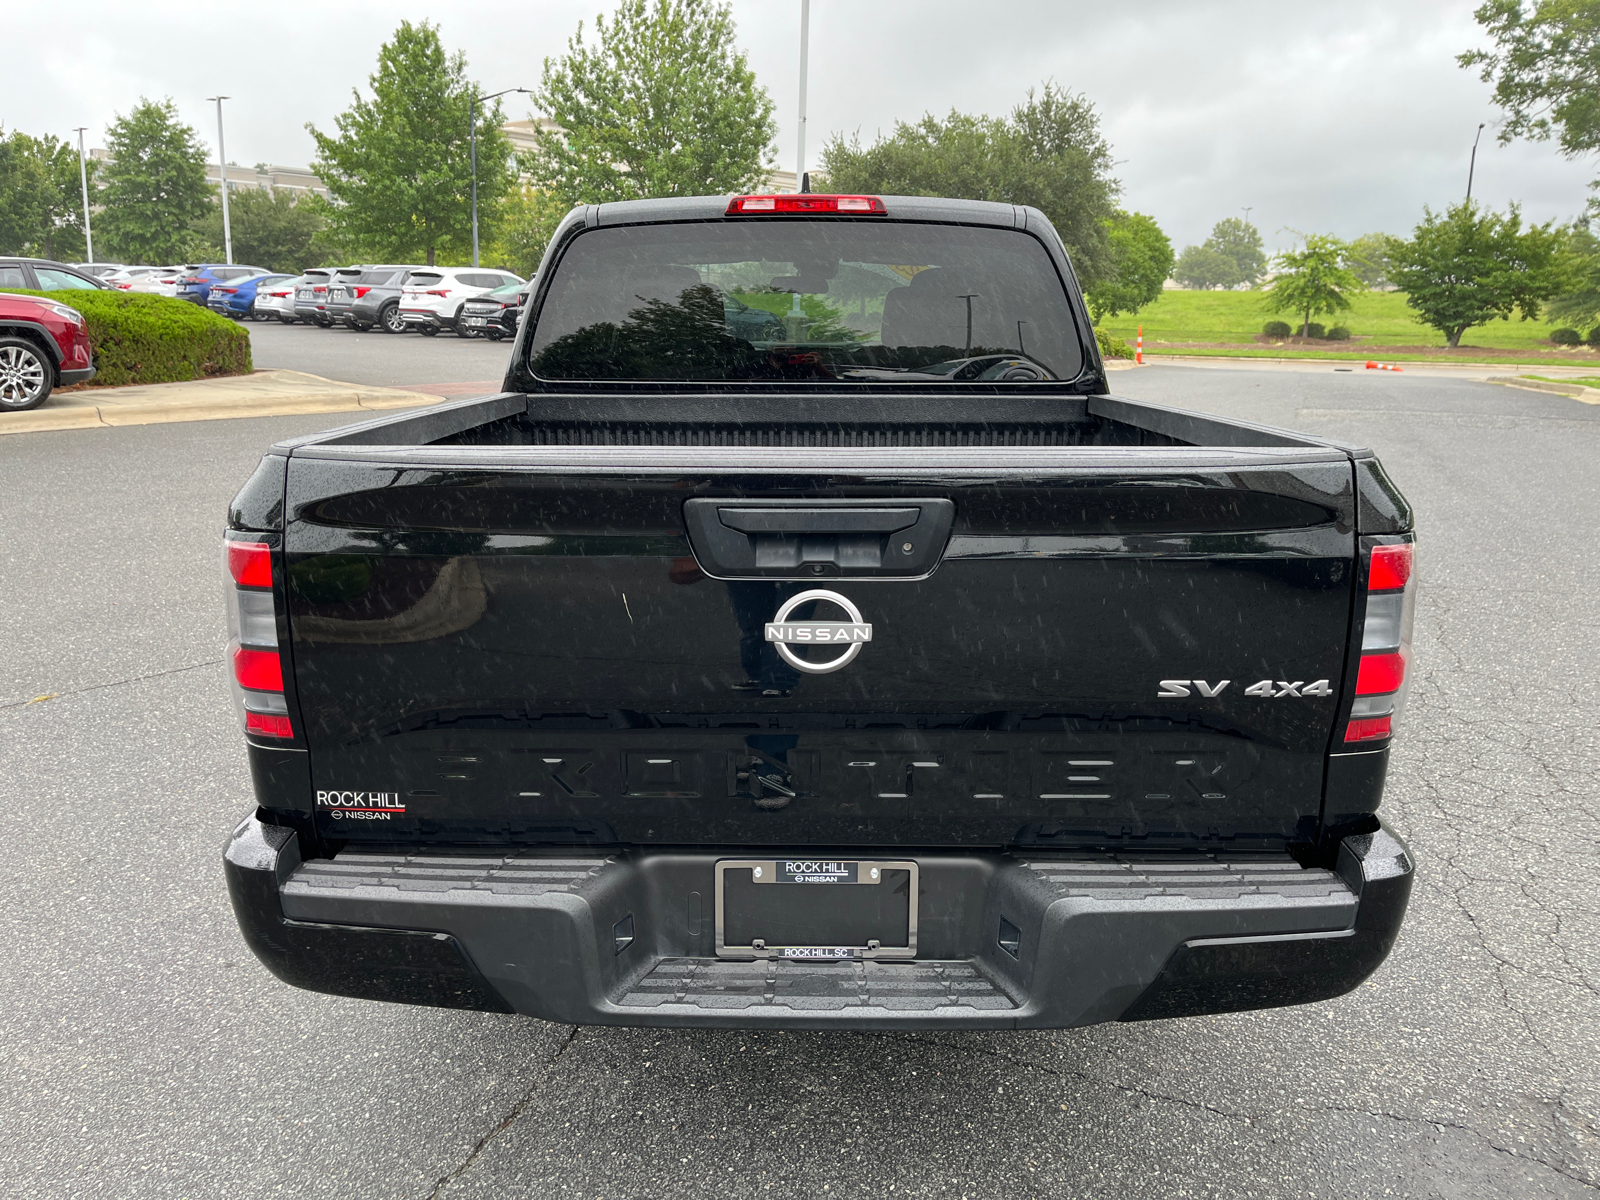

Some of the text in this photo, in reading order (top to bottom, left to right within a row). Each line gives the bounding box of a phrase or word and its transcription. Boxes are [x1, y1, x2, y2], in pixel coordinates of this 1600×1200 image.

[768, 626, 869, 641] NISSAN
[1157, 679, 1231, 698] SV
[316, 790, 406, 808] ROCK HILL
[345, 811, 391, 820] NISSAN
[785, 862, 849, 873] ROCK HILL
[784, 948, 811, 957] ROCK
[834, 948, 848, 957] SC
